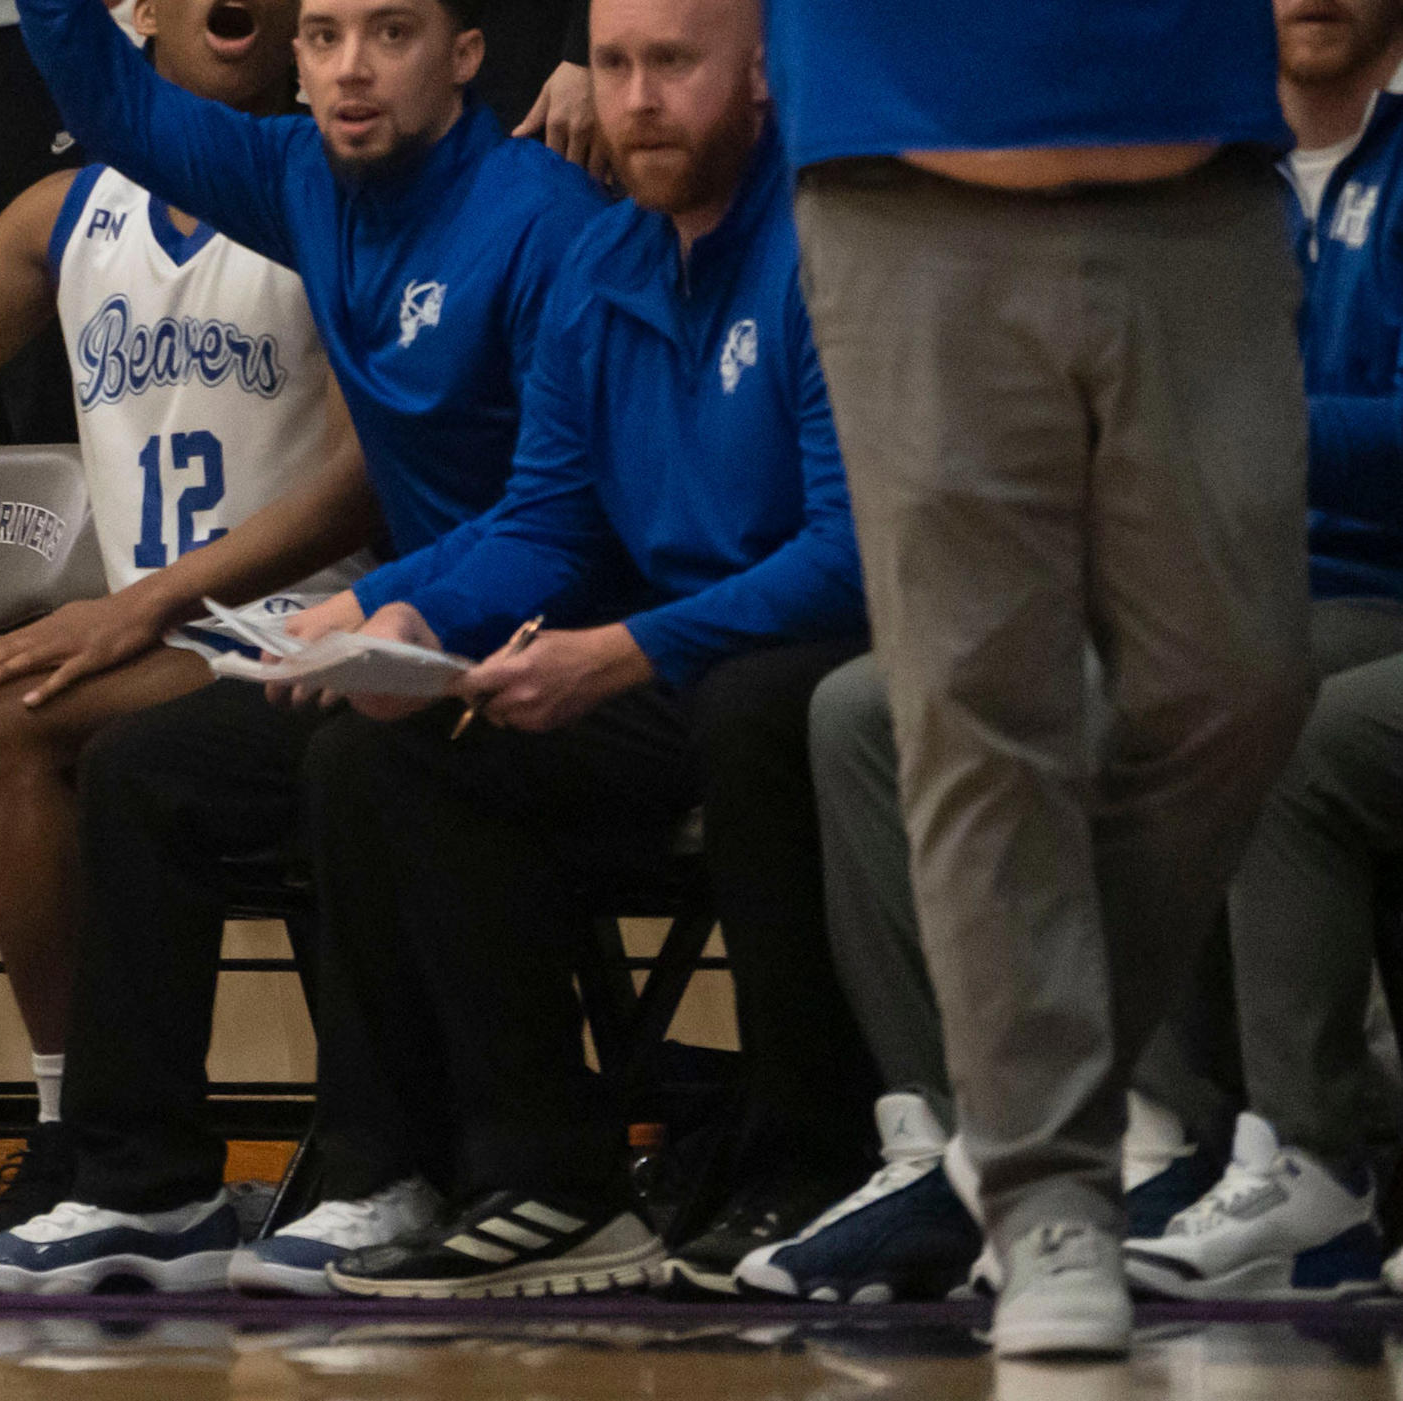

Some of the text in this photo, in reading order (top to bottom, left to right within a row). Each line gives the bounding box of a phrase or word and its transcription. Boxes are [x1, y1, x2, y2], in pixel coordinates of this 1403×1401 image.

[87, 208, 128, 241] PN
[78, 293, 290, 412] Beavers
[134, 430, 229, 568] 12
